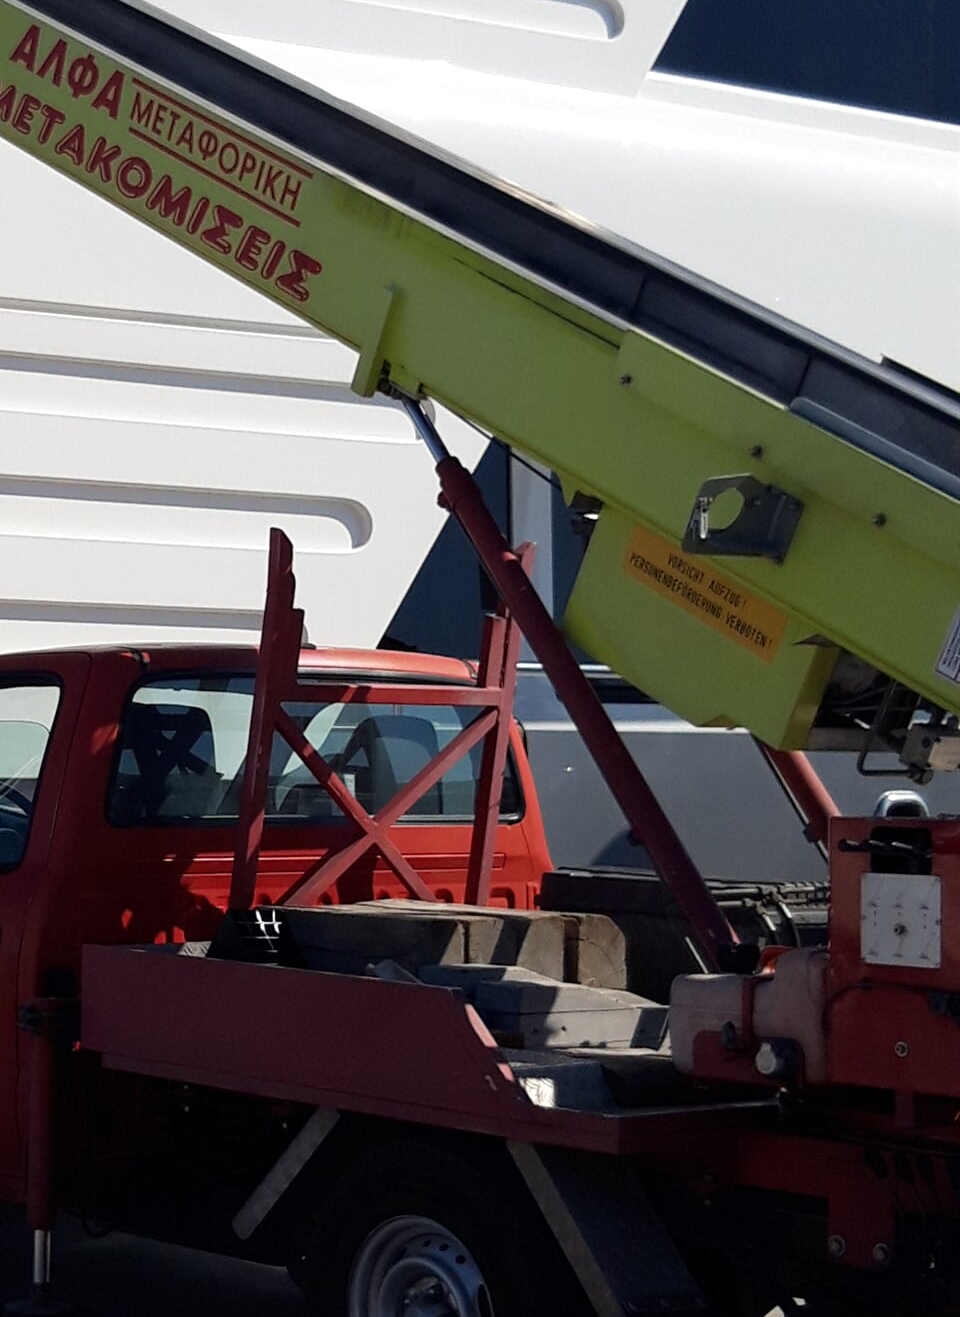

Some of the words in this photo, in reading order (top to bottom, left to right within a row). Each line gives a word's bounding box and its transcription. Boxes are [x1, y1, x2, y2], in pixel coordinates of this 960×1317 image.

[9, 24, 126, 120] ΑΛΦΑ
[128, 91, 304, 211] ΜΕΤΑΦΟΡΙΚΗ
[667, 552, 705, 584] VORSICHT
